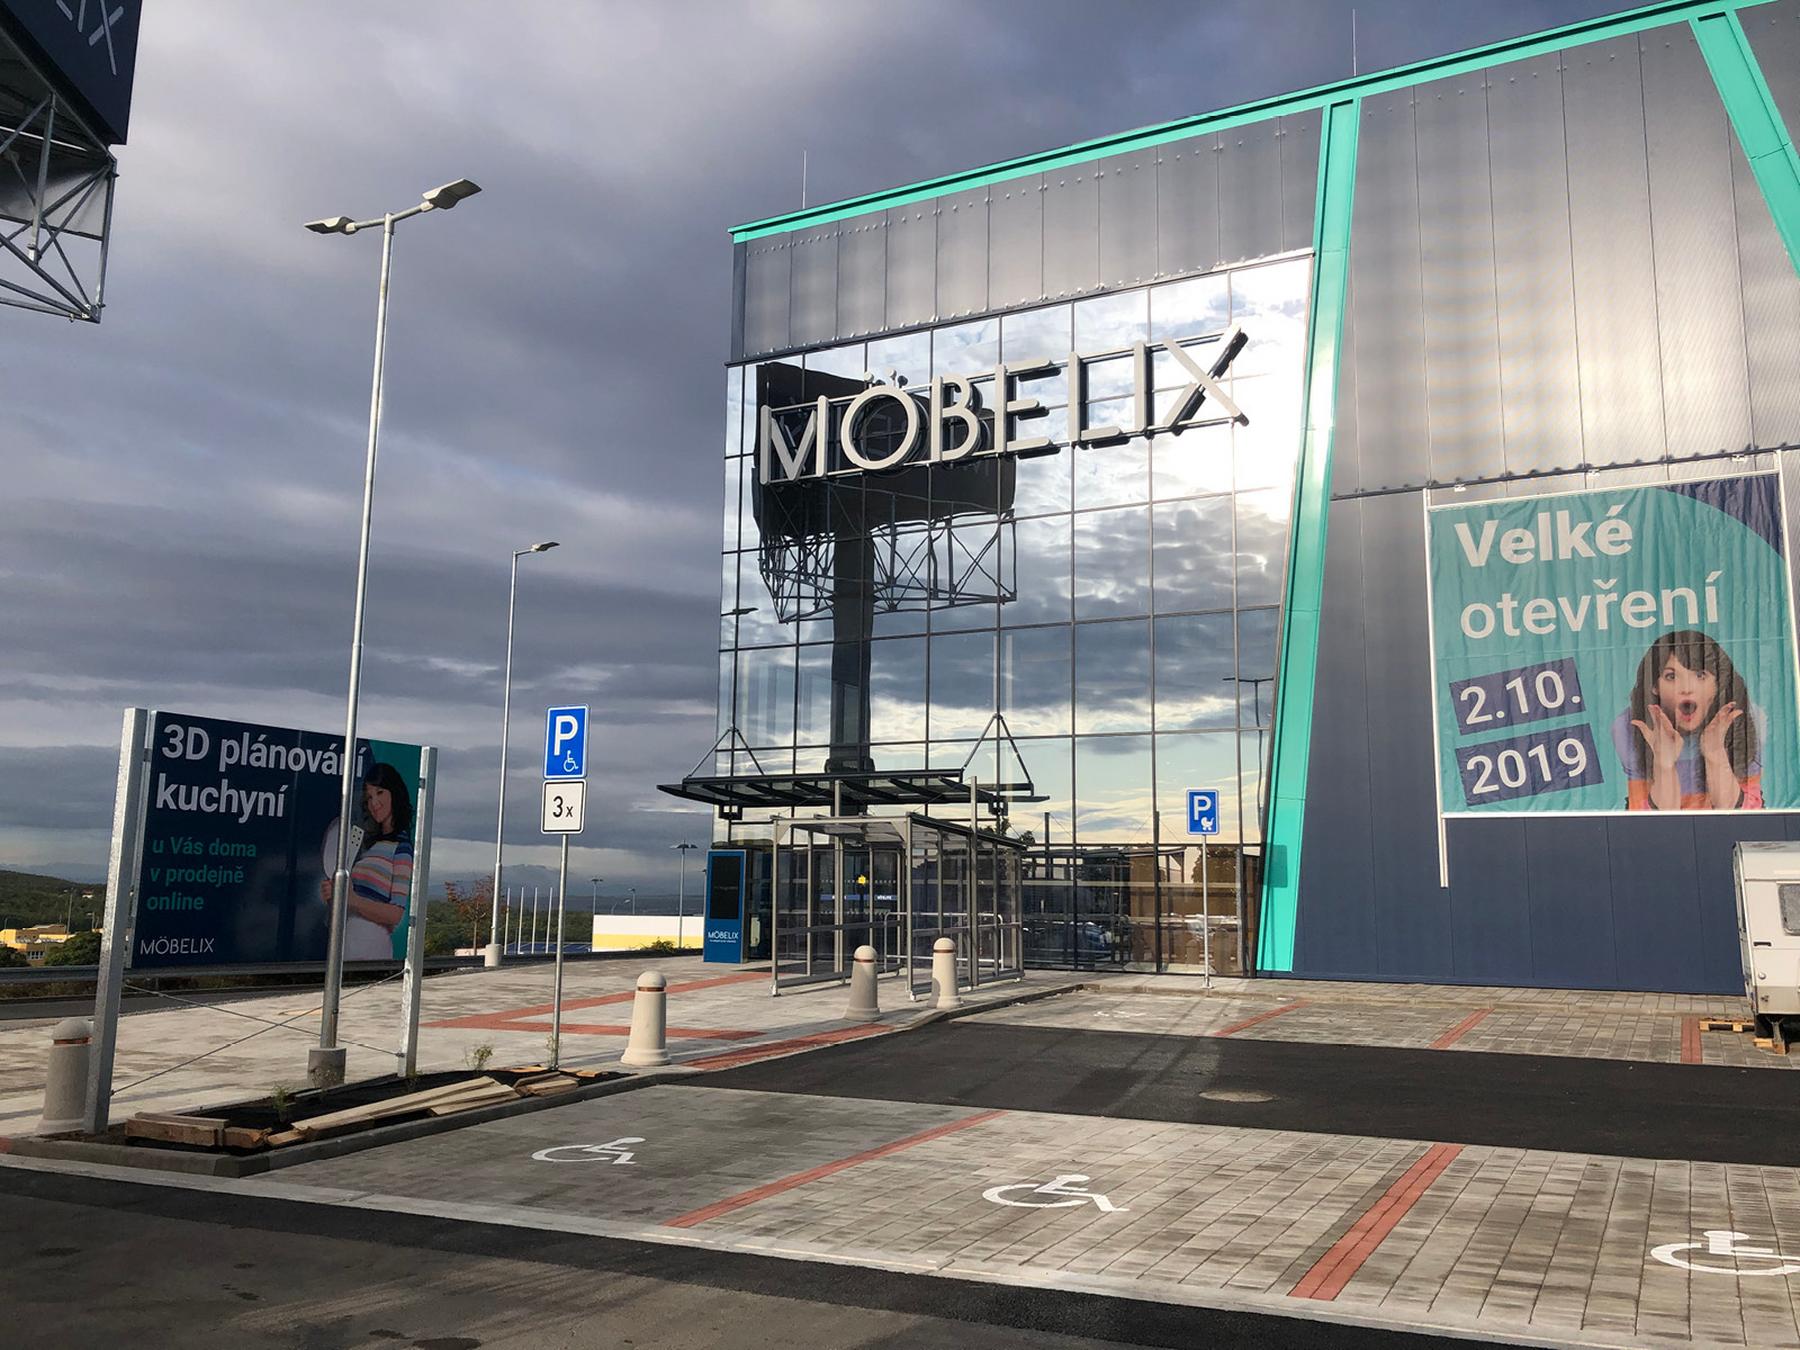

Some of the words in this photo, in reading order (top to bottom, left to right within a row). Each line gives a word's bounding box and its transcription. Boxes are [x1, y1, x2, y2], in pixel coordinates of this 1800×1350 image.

[761, 324, 1249, 485] MÖBELIX
[1453, 504, 1634, 568] Velké
[1460, 570, 1724, 640] otevření
[1459, 669, 1582, 726] 2.10.
[161, 723, 210, 761] 3D
[218, 731, 368, 778] plánováí
[553, 714, 579, 756] P
[1465, 737, 1588, 795] 2019
[155, 773, 288, 824] kuchyní
[1193, 795, 1212, 821] P
[152, 839, 164, 854] u
[170, 836, 204, 855] Vás
[208, 837, 257, 857] doma
[146, 891, 204, 911] online
[150, 867, 161, 882] v
[165, 864, 245, 888] prodejně
[140, 936, 215, 955] MÖBELIX
